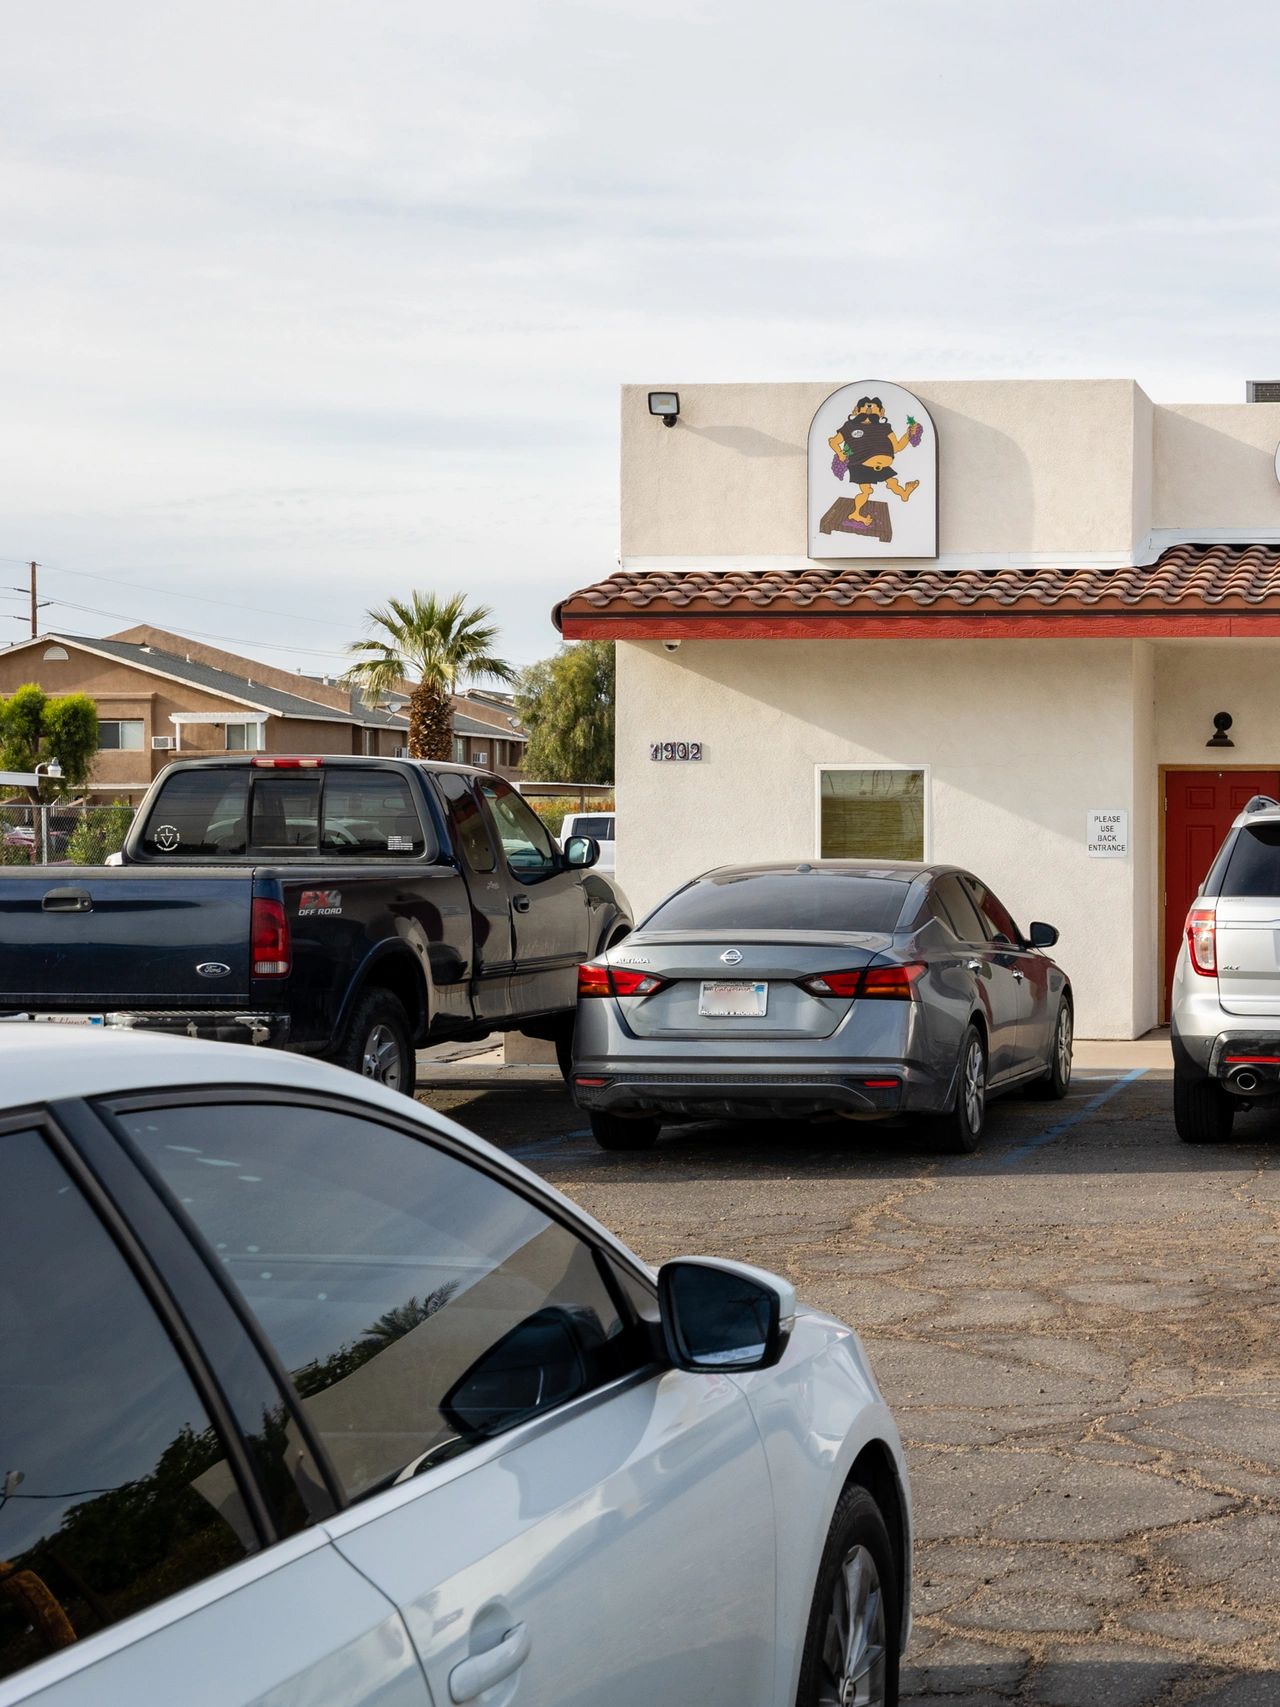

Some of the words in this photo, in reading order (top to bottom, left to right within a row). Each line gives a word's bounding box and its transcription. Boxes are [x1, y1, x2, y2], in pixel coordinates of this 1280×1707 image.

[1094, 815, 1121, 823] PLEASE
[1097, 834, 1117, 842] BACK
[299, 891, 342, 909] FX4
[317, 908, 342, 916] ROAD
